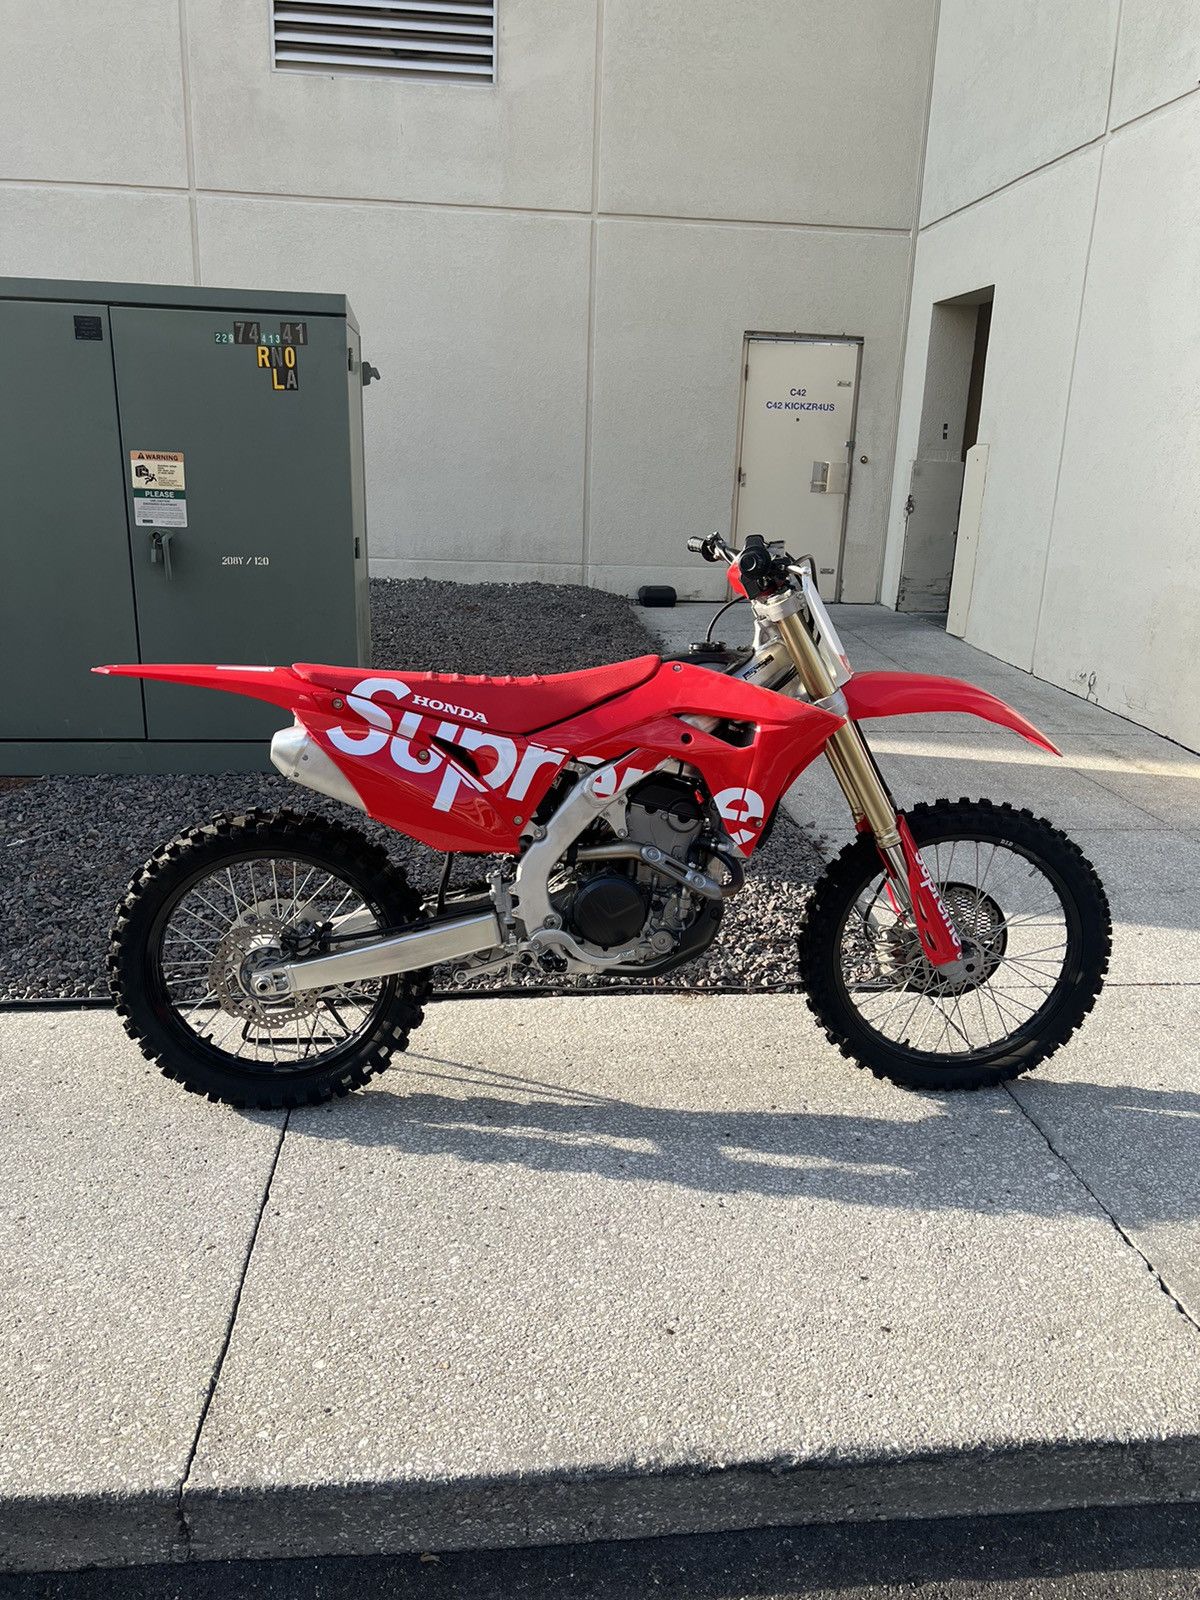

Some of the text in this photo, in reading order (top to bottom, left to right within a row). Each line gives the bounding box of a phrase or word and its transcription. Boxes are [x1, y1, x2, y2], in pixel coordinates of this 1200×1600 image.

[273, 368, 297, 390] LA
[790, 388, 807, 397] C42
[766, 401, 835, 412] C42 KICKZR4US
[145, 453, 179, 462] WARNING
[145, 490, 175, 498] PLEASE
[411, 694, 489, 724] HONDA
[326, 677, 765, 845] Supree
